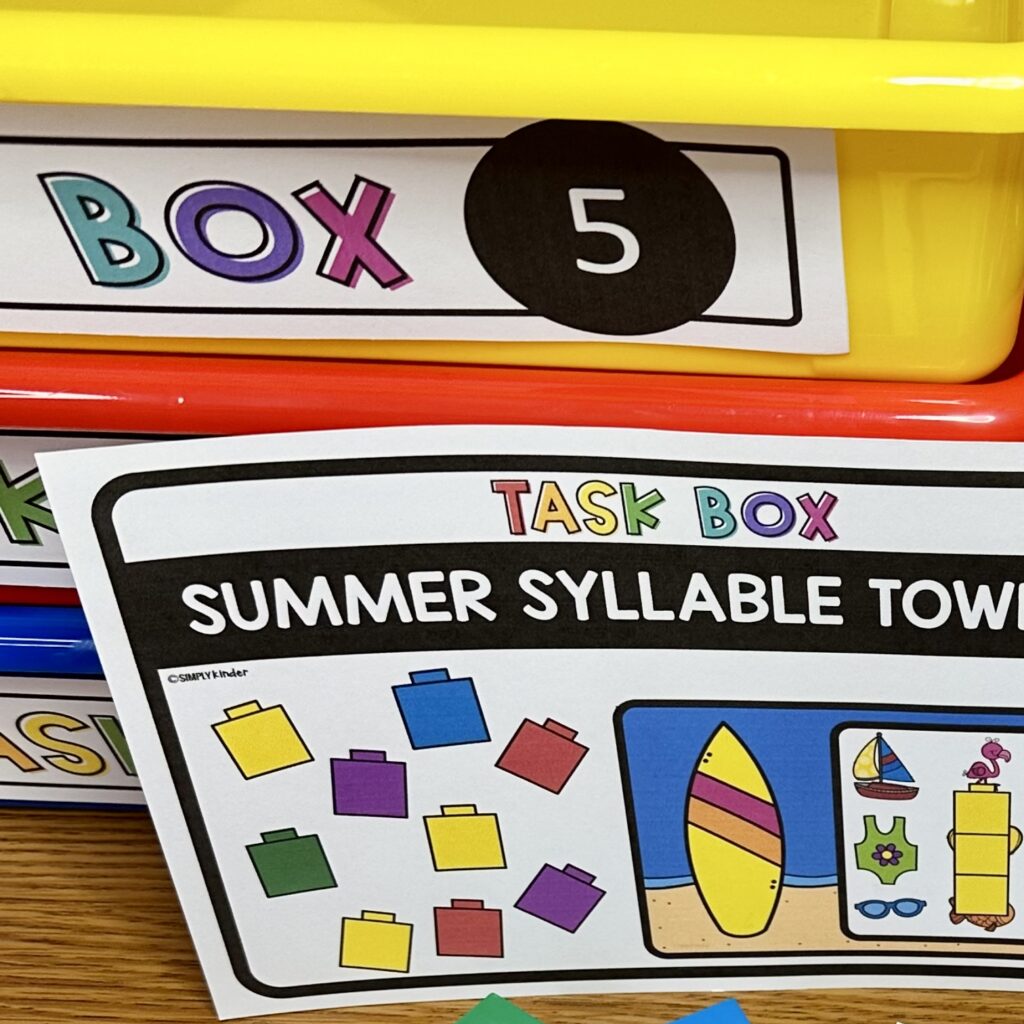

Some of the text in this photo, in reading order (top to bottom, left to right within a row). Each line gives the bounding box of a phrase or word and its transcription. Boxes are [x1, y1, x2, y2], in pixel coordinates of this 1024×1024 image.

[37, 172, 641, 290] BOX 5
[490, 479, 839, 542] TASK BOX
[181, 569, 497, 636] SUMMER
[519, 569, 845, 626] SYLLABLE
